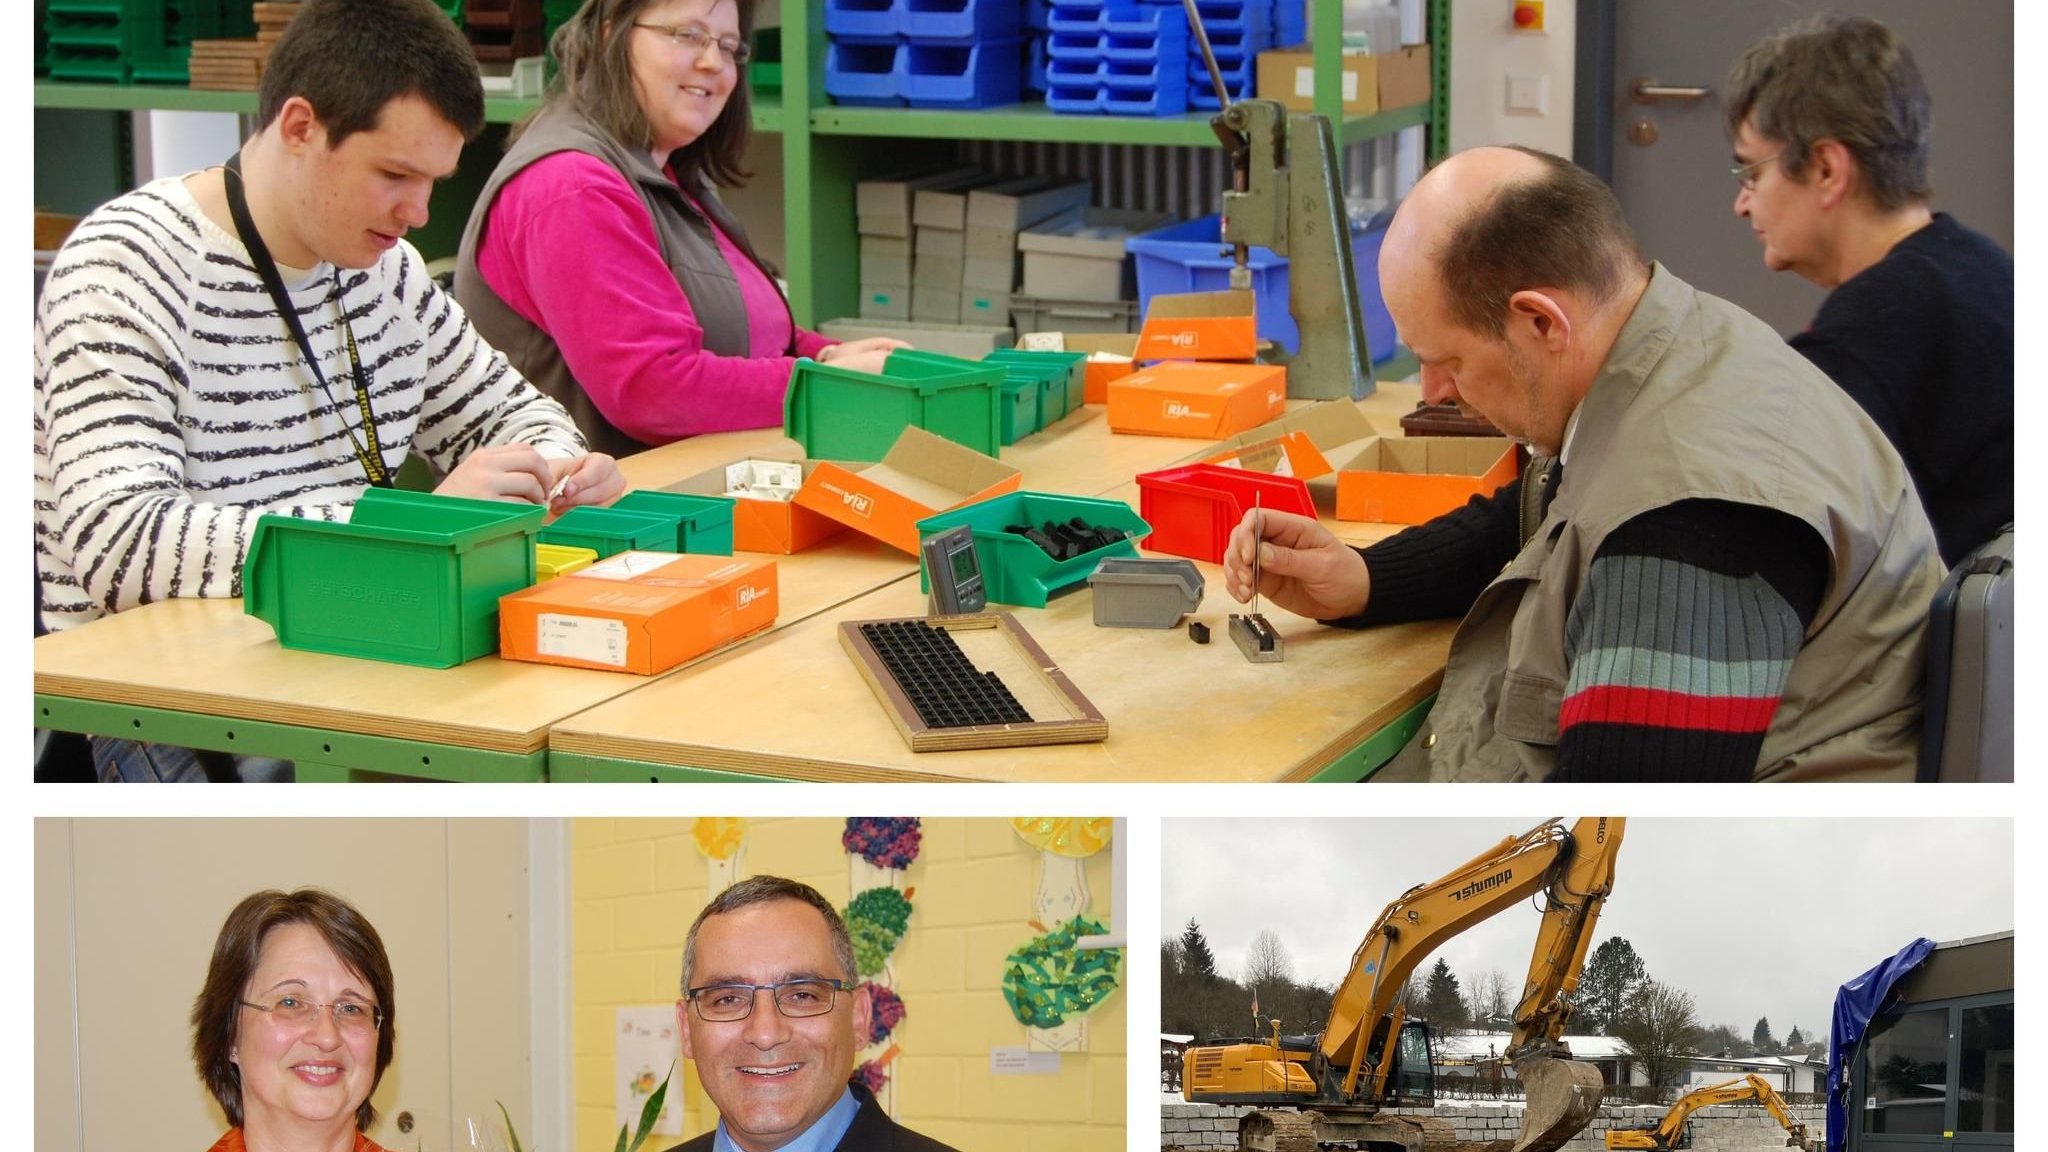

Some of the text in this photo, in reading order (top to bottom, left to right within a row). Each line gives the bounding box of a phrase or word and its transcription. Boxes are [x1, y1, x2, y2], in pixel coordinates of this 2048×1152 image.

[1167, 404, 1189, 415] RIA
[843, 491, 868, 512] RIA
[740, 586, 755, 606] RIA
[1462, 868, 1513, 899] stumpp
